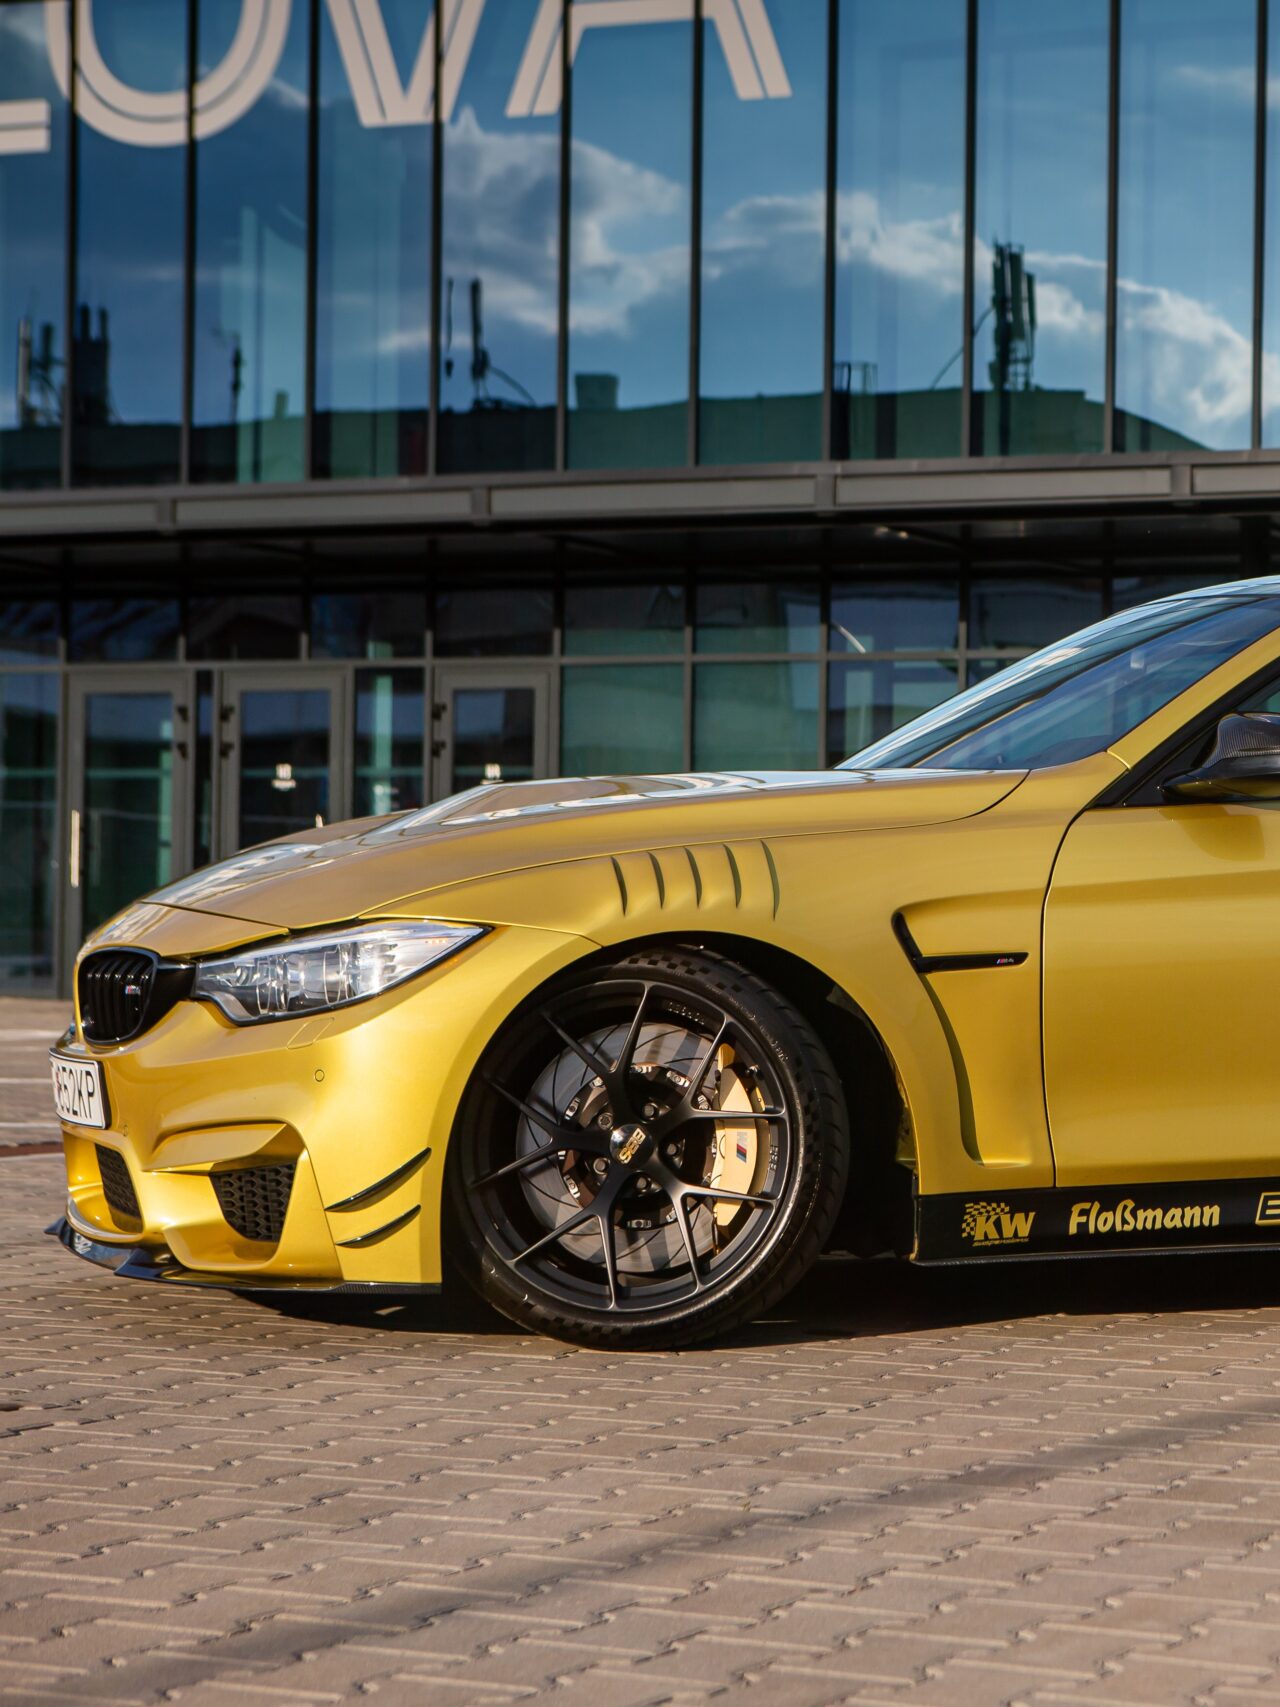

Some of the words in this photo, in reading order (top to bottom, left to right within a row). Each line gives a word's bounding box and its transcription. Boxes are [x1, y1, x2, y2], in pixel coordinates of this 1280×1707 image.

[619, 1128, 646, 1164] BBS
[974, 1212, 1036, 1240] KW
[1069, 1199, 1220, 1235] Floßmann
